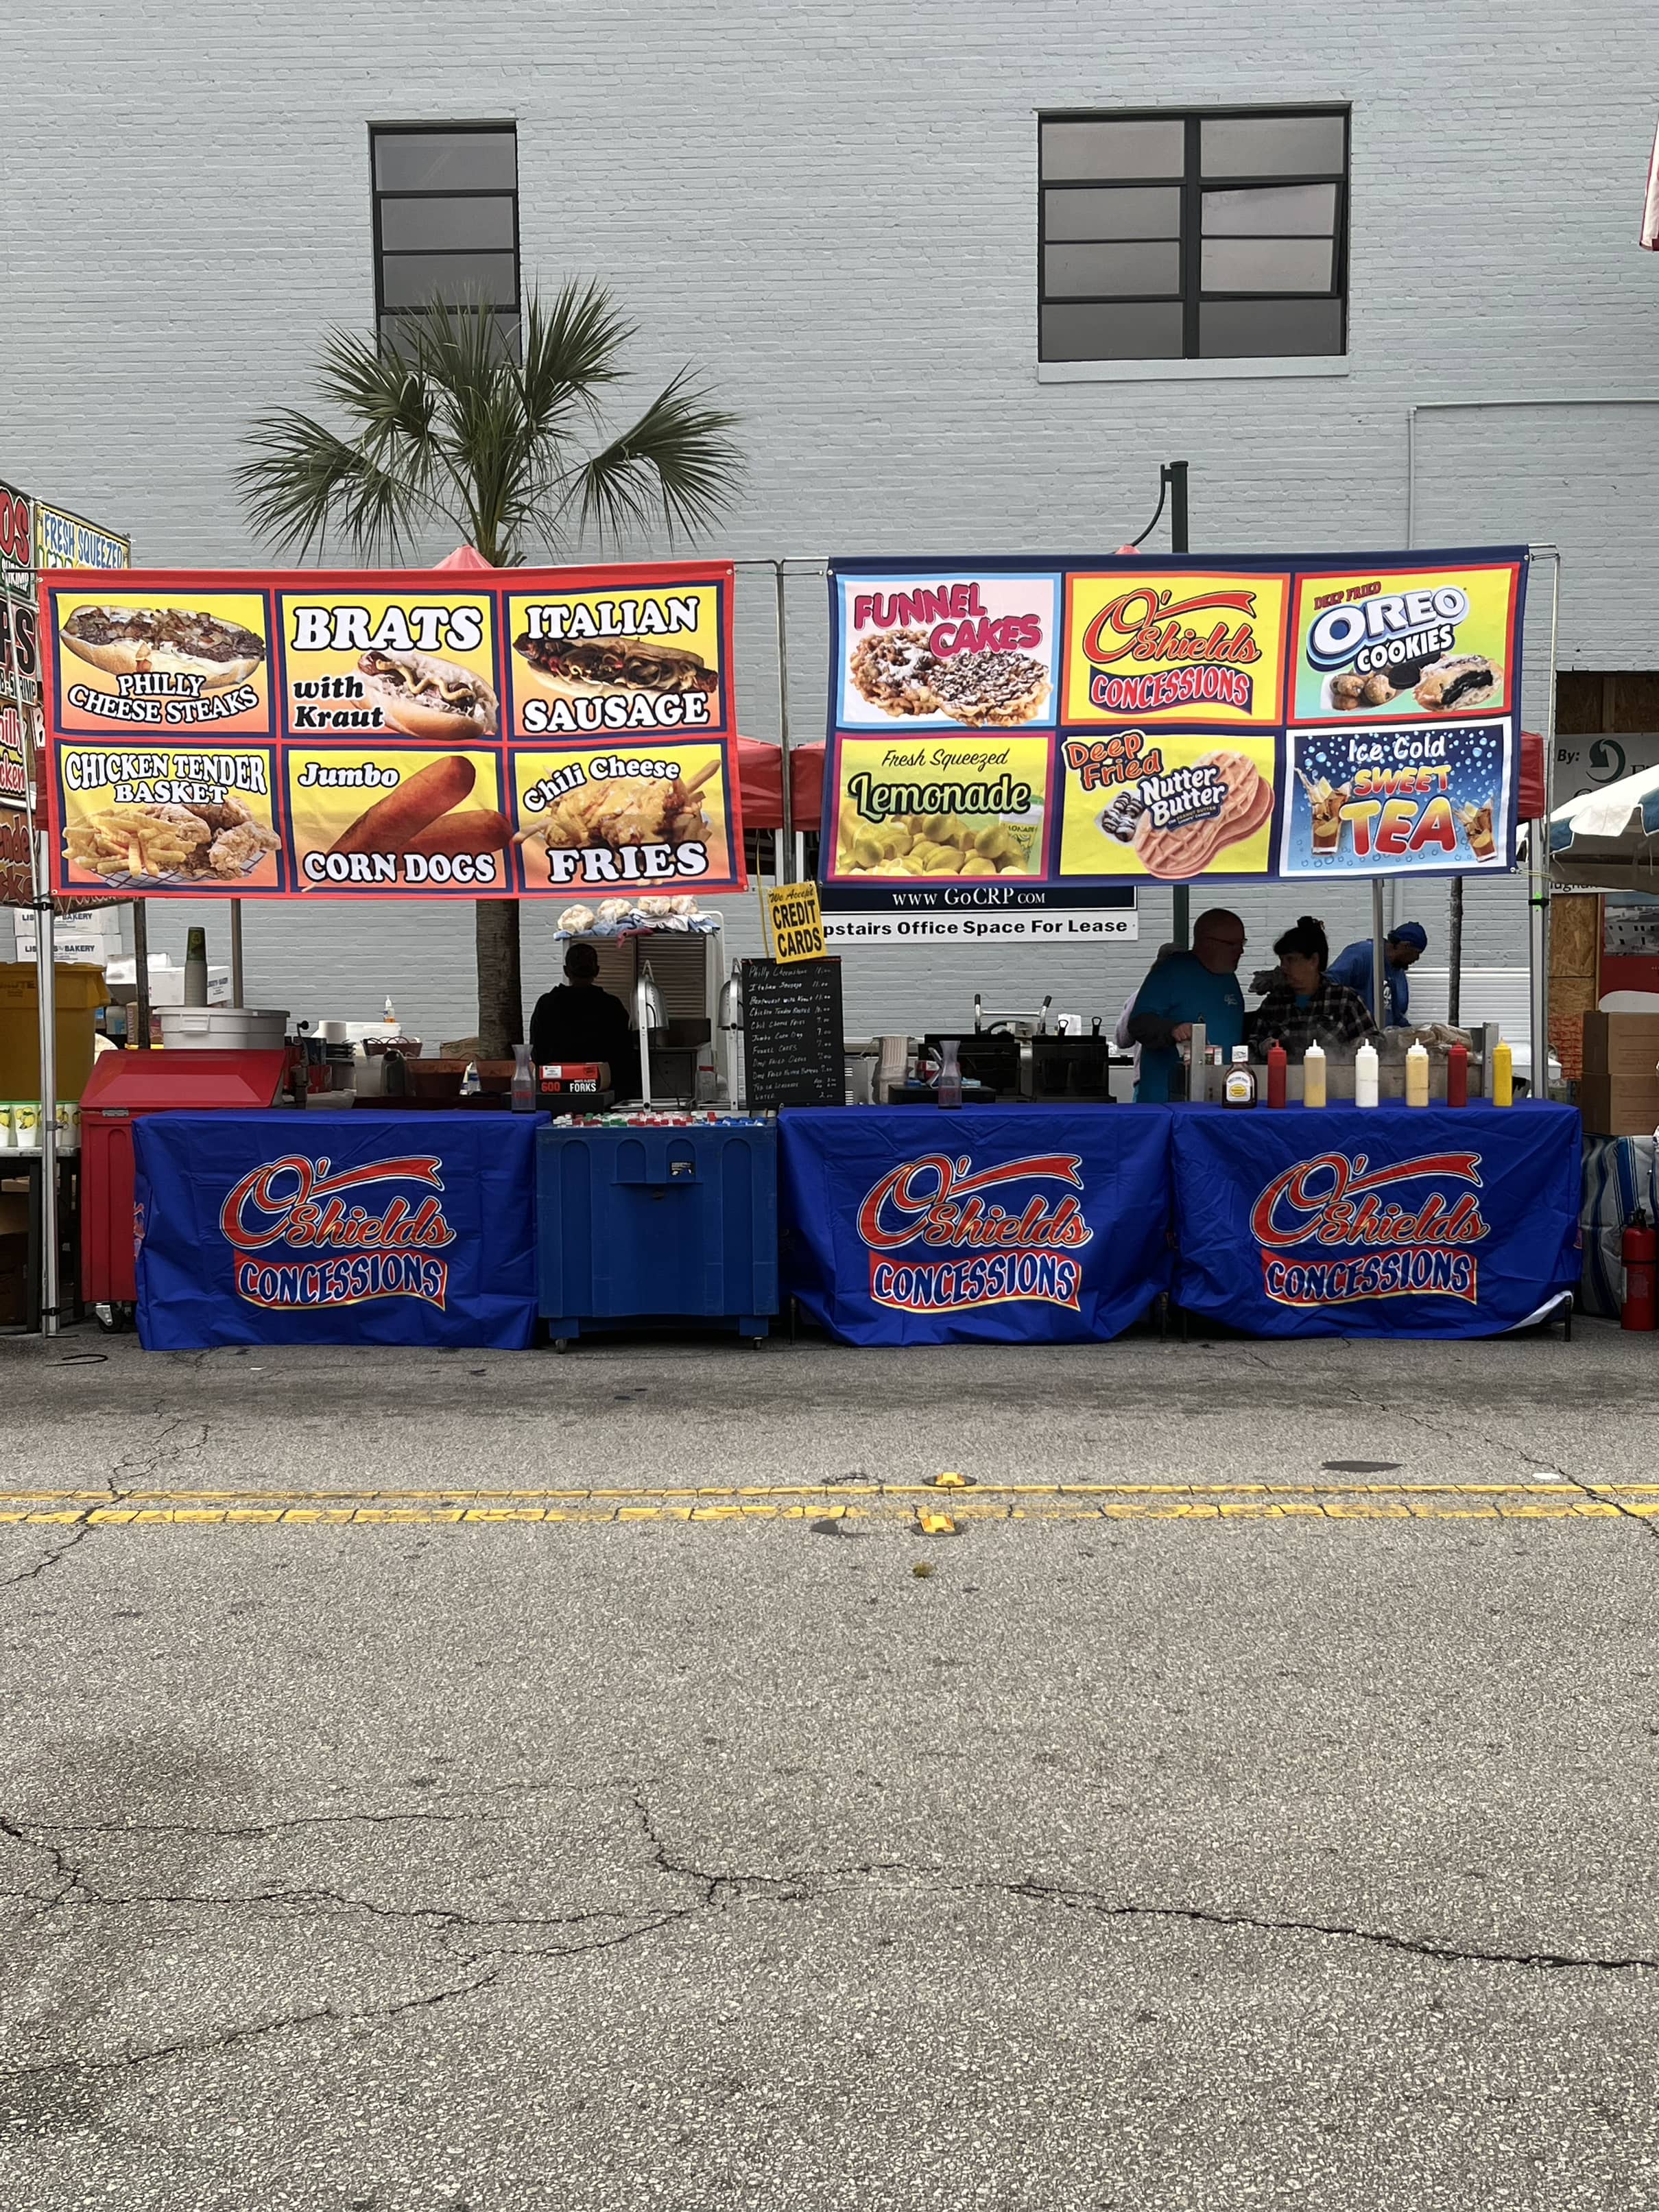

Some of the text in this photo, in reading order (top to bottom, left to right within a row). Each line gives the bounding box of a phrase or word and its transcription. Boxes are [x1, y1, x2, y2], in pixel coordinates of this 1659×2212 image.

[43, 514, 75, 560] FRESH
[77, 527, 123, 569] SQUEEZED
[853, 582, 987, 630] FUNNEL
[1313, 581, 1382, 610] DEEP FRIED
[292, 606, 483, 652] BRATS
[525, 596, 700, 640] ITALIAN
[929, 613, 1042, 659] CAKES
[1311, 586, 1468, 661] OREO
[1355, 623, 1455, 675] COOKIES
[116, 672, 206, 698] PHILLY
[292, 676, 365, 699] with
[1090, 665, 1251, 711] CONCESSIONS
[68, 685, 259, 724] CHEESE STEAKS
[292, 705, 384, 728] Kraut
[523, 691, 709, 733] SAUSAGE
[881, 748, 1010, 772] Fresh Squeezed
[1064, 731, 1143, 768] Deep
[1349, 736, 1446, 763] Ice Cold
[1556, 749, 1580, 765] By:
[64, 752, 267, 794] CHICKEN TENDER
[298, 761, 400, 788] Jumbo
[523, 755, 681, 813] Chili Cheese
[1082, 751, 1163, 789] Fried
[1141, 768, 1217, 806] Nutter
[1352, 764, 1452, 796] SWEET
[115, 781, 228, 805] BASKET
[848, 772, 1031, 823] Lemonade
[1151, 786, 1226, 826] Butter
[1339, 797, 1457, 857] TEA
[302, 852, 496, 883] CORN DOGS
[547, 842, 708, 883] FRIES
[768, 888, 814, 903] We Accept
[773, 900, 815, 930] CREDIT
[823, 918, 1127, 939] pstairs Office Space For Lease
[777, 927, 822, 958] CARDS
[541, 1081, 597, 1093] 600 FORKS
[239, 1253, 444, 1305] CONCESSIONS
[873, 1252, 1077, 1306] CONCESSIONS
[1265, 1249, 1472, 1300] CONCESSIONS
